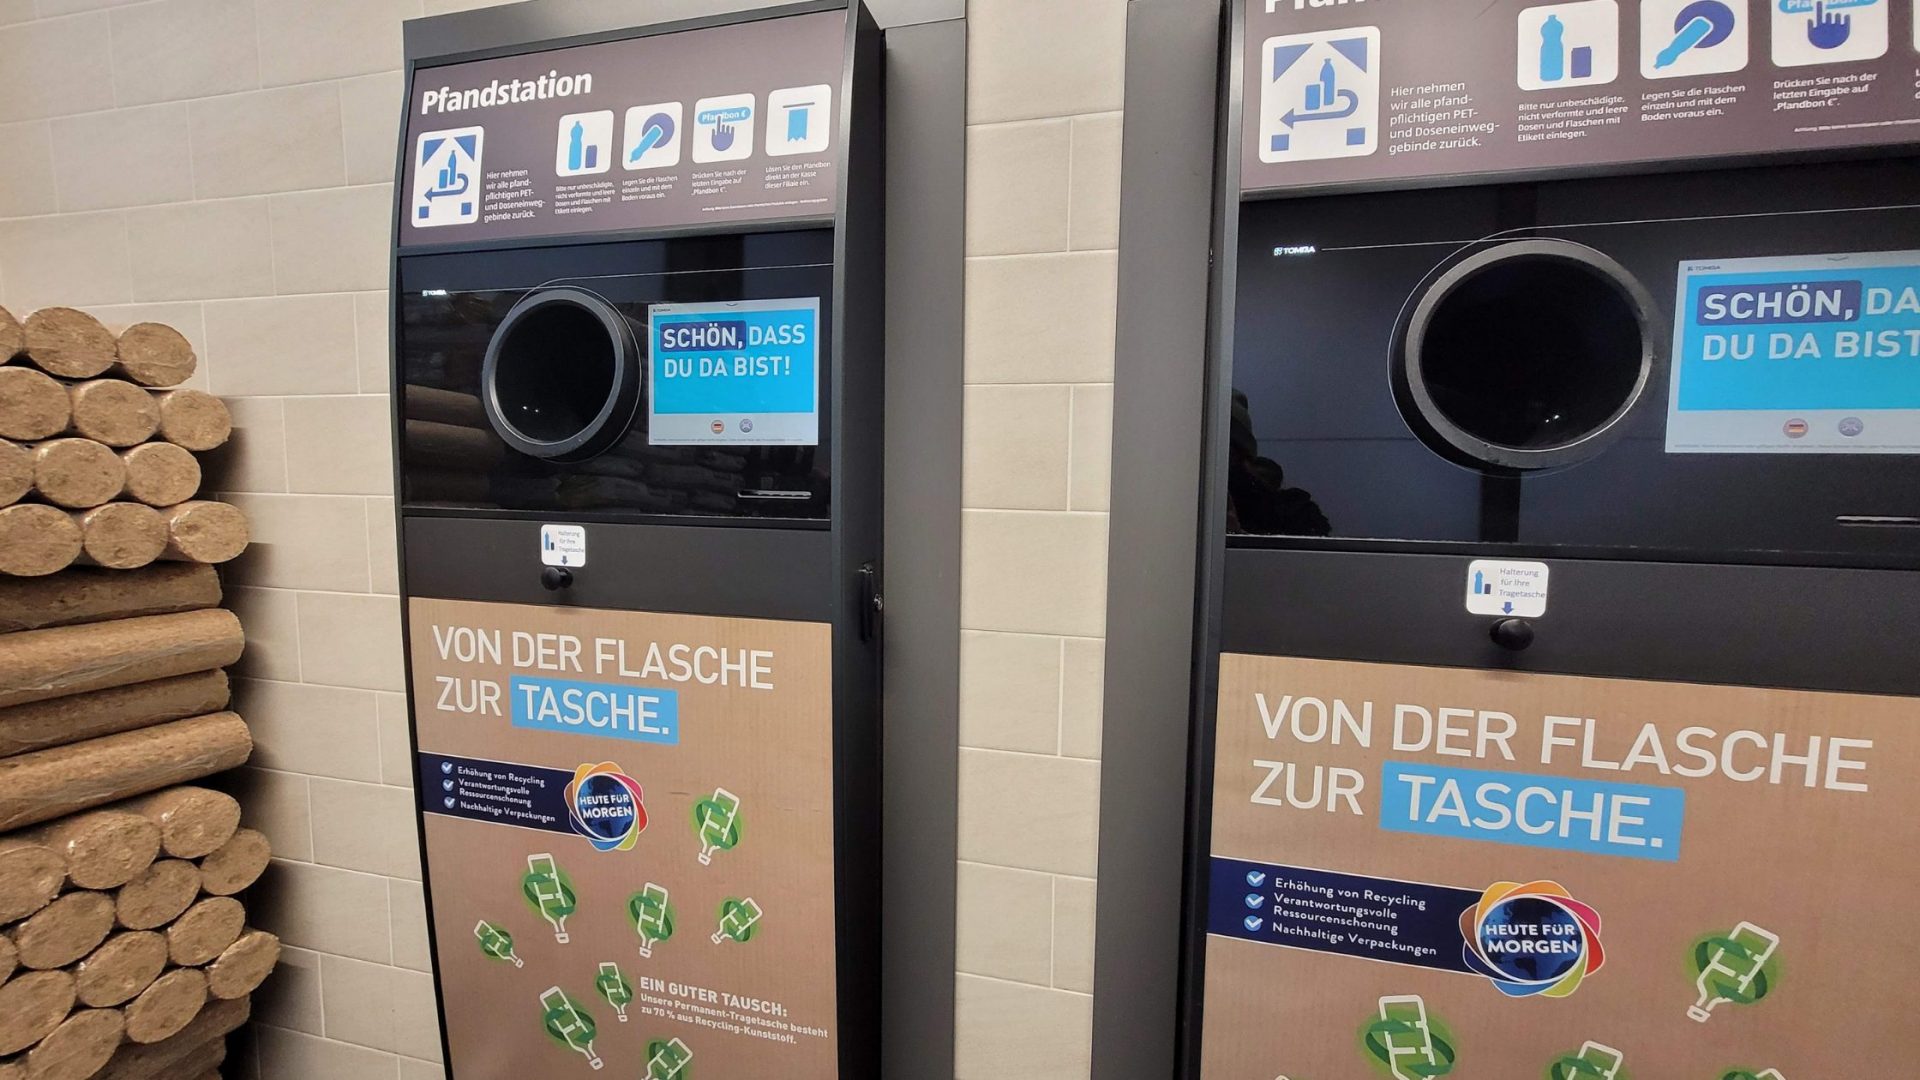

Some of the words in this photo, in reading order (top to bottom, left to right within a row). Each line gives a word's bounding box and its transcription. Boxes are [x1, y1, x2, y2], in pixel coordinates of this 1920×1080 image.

[1773, 79, 1814, 89] Drücken
[1815, 76, 1831, 85] Sie
[1832, 74, 1858, 84] nach
[1859, 72, 1878, 82] der
[421, 69, 592, 115] Pfandstation
[1390, 86, 1414, 97] Hier
[1416, 82, 1465, 95] nehmen
[1641, 92, 1670, 101] Legen
[1671, 89, 1686, 98] Sie
[1687, 88, 1702, 97] die
[1703, 84, 1746, 95] Flaschen
[1773, 90, 1807, 100] letzten
[1808, 85, 1850, 98] Eingabe
[1851, 84, 1870, 93] auf
[1390, 100, 1408, 111] wir
[1410, 98, 1431, 109] alle
[1433, 94, 1473, 109] pfand-
[1518, 103, 1538, 111] Bitte
[1540, 102, 1555, 110] nur
[1556, 95, 1626, 108] unbeschädigte,
[1641, 101, 1675, 111] einzeln
[1676, 99, 1696, 108] und
[1697, 97, 1713, 106] mit
[1714, 96, 1737, 105] dem
[1390, 112, 1451, 127] pflichtigen
[1453, 108, 1479, 119] PET-
[1518, 112, 1540, 121] nicht
[1541, 109, 1584, 120] verformte
[1585, 107, 1604, 116] und
[1605, 105, 1629, 114] leere
[1641, 112, 1671, 122] Boden
[1673, 109, 1705, 119] voraus
[1706, 107, 1725, 116] ein.
[1389, 127, 1413, 139] und
[1415, 122, 1500, 137] Doseneinweg-
[1518, 123, 1545, 132] Dosen
[1546, 120, 1564, 129] und
[1565, 117, 1604, 128] Flaschen
[1605, 116, 1621, 125] mit
[1517, 133, 1545, 142] Etikett
[1546, 130, 1588, 140] einlegen.
[1389, 140, 1437, 156] gebinde
[1439, 136, 1482, 150] zurück.
[486, 172, 500, 180] Hier
[500, 169, 528, 178] nehmen
[485, 181, 496, 190] wir
[497, 180, 509, 189] alle
[485, 190, 520, 203] pflichtigen
[520, 188, 534, 198] PET-
[484, 202, 498, 211] und
[499, 199, 546, 210] Doseneinweg-
[484, 212, 511, 224] gebinde
[511, 209, 536, 220] zurück.
[1703, 284, 1853, 321] SCHÖN,
[663, 322, 743, 349] SCHÖN,
[748, 324, 806, 346] DASS
[1702, 334, 1755, 361] DU
[1768, 332, 1822, 360] DA
[664, 358, 693, 378] DU
[700, 357, 728, 377] DA
[734, 355, 791, 377] BIST!
[1499, 567, 1539, 578] Halterung
[1514, 579, 1530, 587] Ihre
[1499, 588, 1546, 599] Tragetasche
[432, 624, 502, 665] VON
[512, 631, 583, 673] DER
[595, 637, 774, 690] FLASCHE
[435, 675, 502, 717] ZUR
[518, 683, 669, 735] TASCHE.
[1254, 693, 1372, 749] VON
[1392, 703, 1518, 761] DER
[1540, 715, 1874, 792] FLASCHE
[457, 765, 492, 781] Erhöhung
[508, 773, 545, 788] Recycling
[458, 778, 530, 795] Verantwortungsvolle
[459, 788, 532, 808] Ressourcenschonung
[579, 794, 610, 805] HEUTE
[610, 793, 630, 803] FÜR
[1249, 759, 1365, 815] ZUR
[1398, 773, 1663, 849] TASCHE.
[460, 800, 503, 816] Nachhaltige
[503, 807, 556, 823] Verpackungen
[582, 806, 633, 819] MORGEN
[1275, 877, 1334, 899] Erhöhung
[1337, 889, 1360, 899] von
[1364, 889, 1427, 911] Recycling
[1273, 892, 1398, 919] Verantwortungsvolle
[1273, 905, 1399, 936] Ressourcenschonung
[1485, 924, 1539, 936] HEUTE
[1542, 923, 1575, 936] FÜR
[1272, 921, 1345, 945] Nachhaltige
[1347, 932, 1437, 957] Verpackungen
[1487, 939, 1578, 954] MORGEN
[640, 976, 665, 993] EIN
[668, 982, 718, 1004] GUTER
[721, 992, 788, 1017] TAUSCH:
[640, 993, 673, 1007] Unsere
[674, 1000, 788, 1031] Permanent-Tragetasche
[790, 1023, 829, 1038] besteht
[641, 1006, 652, 1015] zu
[654, 1006, 665, 1017] 70
[666, 1009, 676, 1020] %
[677, 1014, 694, 1023] aus
[695, 1015, 798, 1044] Recycling-Kunststoff.
